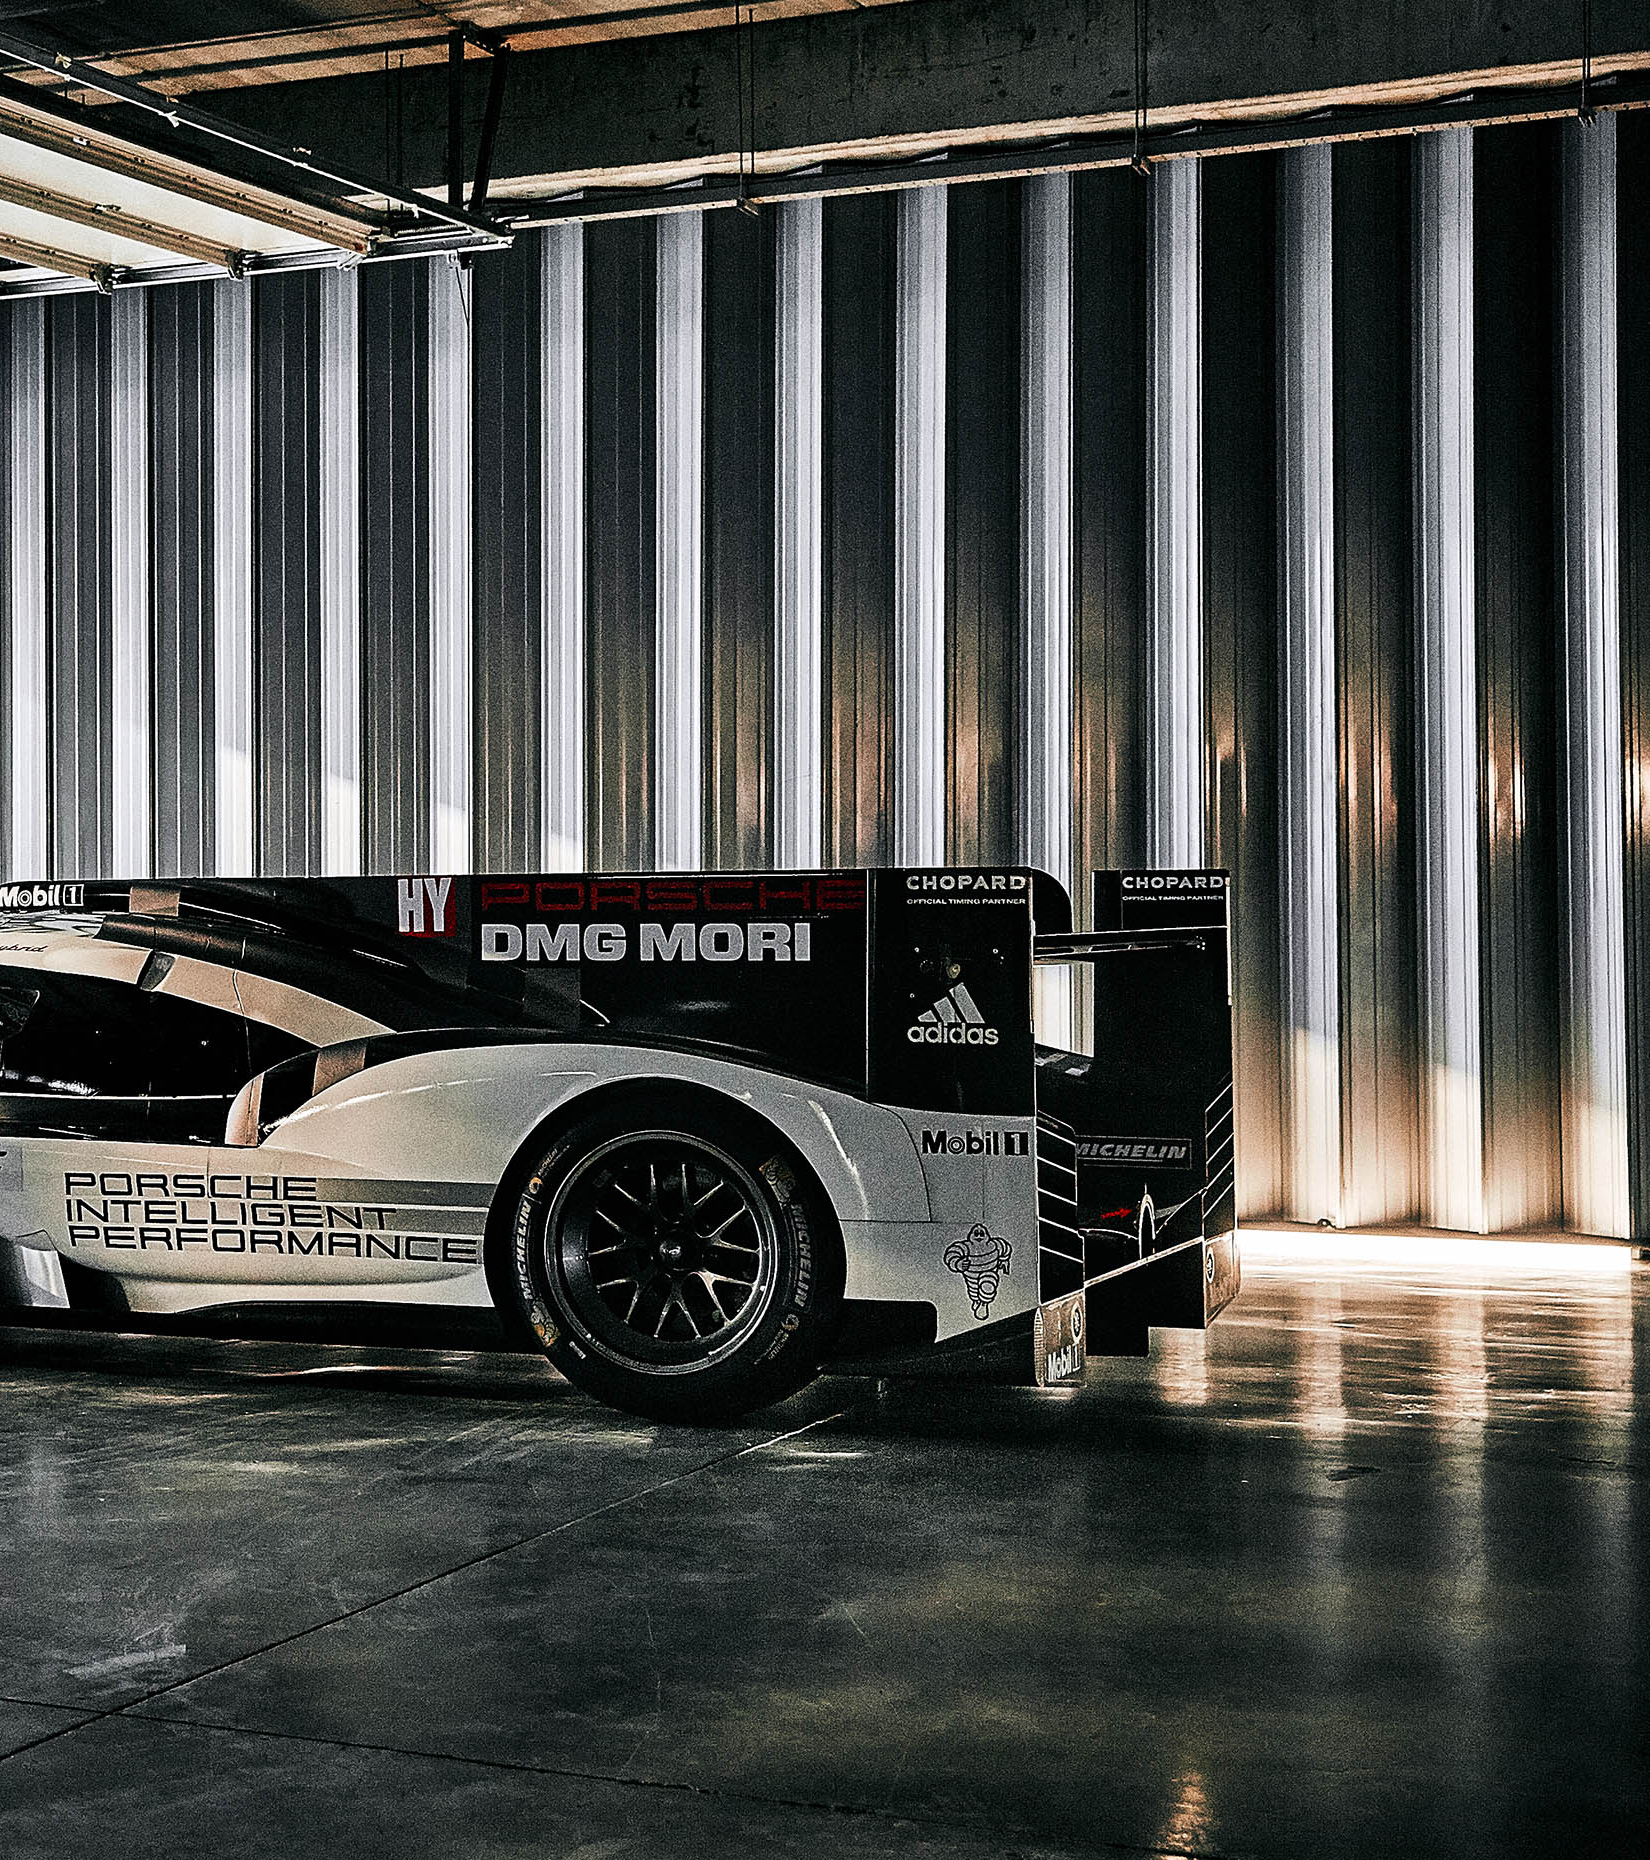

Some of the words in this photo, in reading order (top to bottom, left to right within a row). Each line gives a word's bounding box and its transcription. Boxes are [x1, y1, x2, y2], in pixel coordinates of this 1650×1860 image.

[481, 879, 866, 912] PORSCHE
[906, 875, 1026, 891] CHOPARD
[1121, 876, 1225, 889] CHOPARD
[398, 877, 452, 932] HY
[481, 923, 626, 962] DMG
[640, 922, 811, 962] MORI
[907, 1024, 999, 1046] adidas
[921, 1129, 999, 1155] Mobil
[64, 1172, 317, 1200] PORSCHE
[66, 1200, 397, 1231] INTELLIGENT
[69, 1225, 478, 1264] PERFORMANCE
[516, 1200, 534, 1300] MICHELIN
[791, 1204, 812, 1308] MICHELIN
[1048, 1345, 1072, 1382] Mobil
